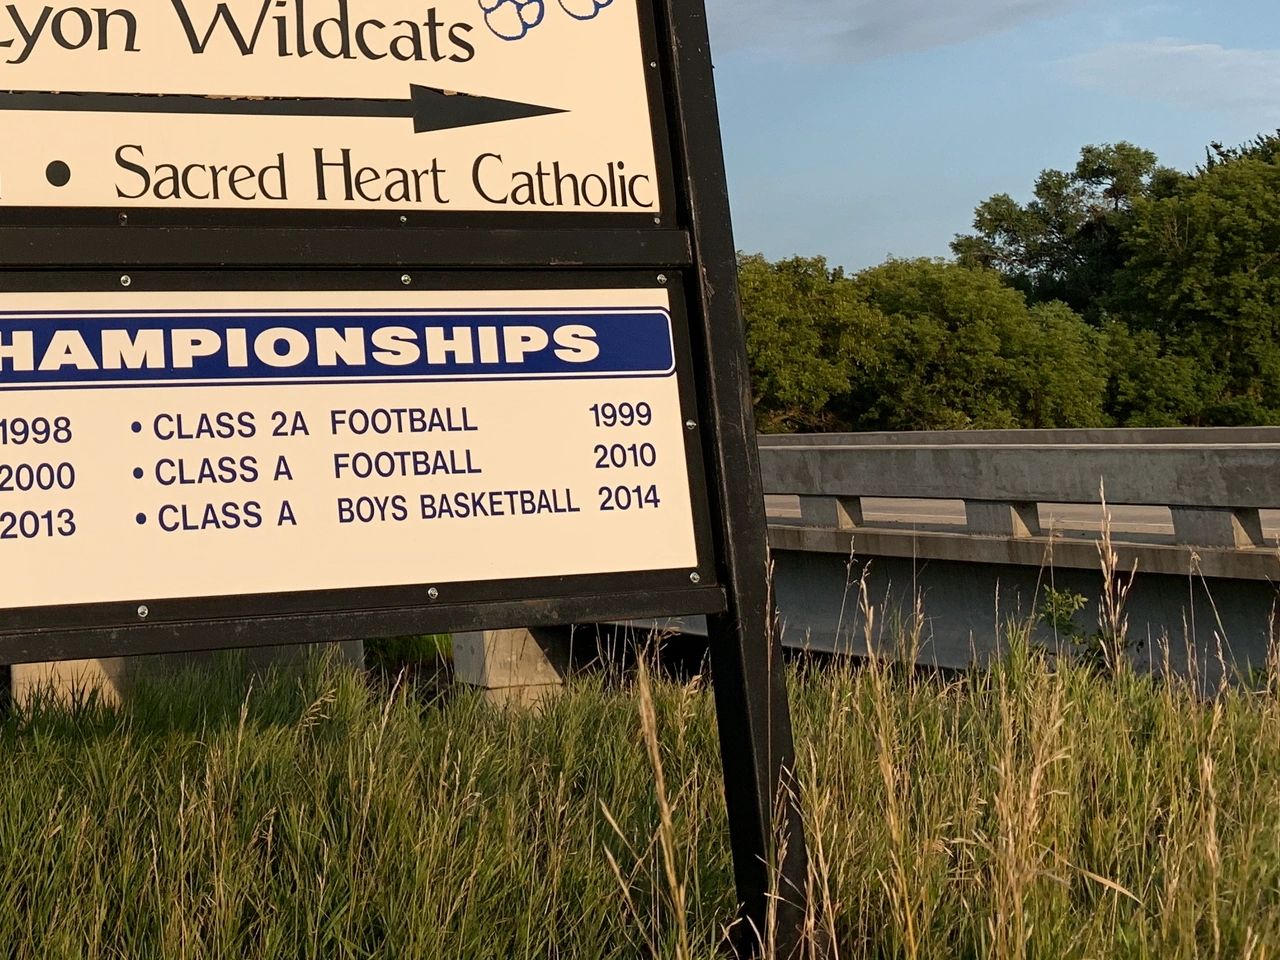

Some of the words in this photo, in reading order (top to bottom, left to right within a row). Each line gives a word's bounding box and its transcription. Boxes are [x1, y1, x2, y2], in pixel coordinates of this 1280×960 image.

[115, 145, 287, 200] Sacred
[313, 148, 447, 203] Heart
[472, 153, 655, 207] Catholic
[154, 412, 256, 440] CLASS
[272, 411, 309, 436] 2A
[331, 407, 478, 434] FOOTBALL
[589, 402, 651, 427] 1999
[156, 456, 258, 485] CLASS
[274, 456, 293, 480] A
[334, 450, 481, 478] FOOTBALL
[594, 443, 656, 468] 2010
[0, 509, 76, 539] 2013
[159, 501, 262, 531] CLASS
[278, 501, 296, 526] A
[338, 495, 407, 523] BOYS
[420, 489, 580, 519] BASKETBALL
[599, 485, 660, 510] 2014
